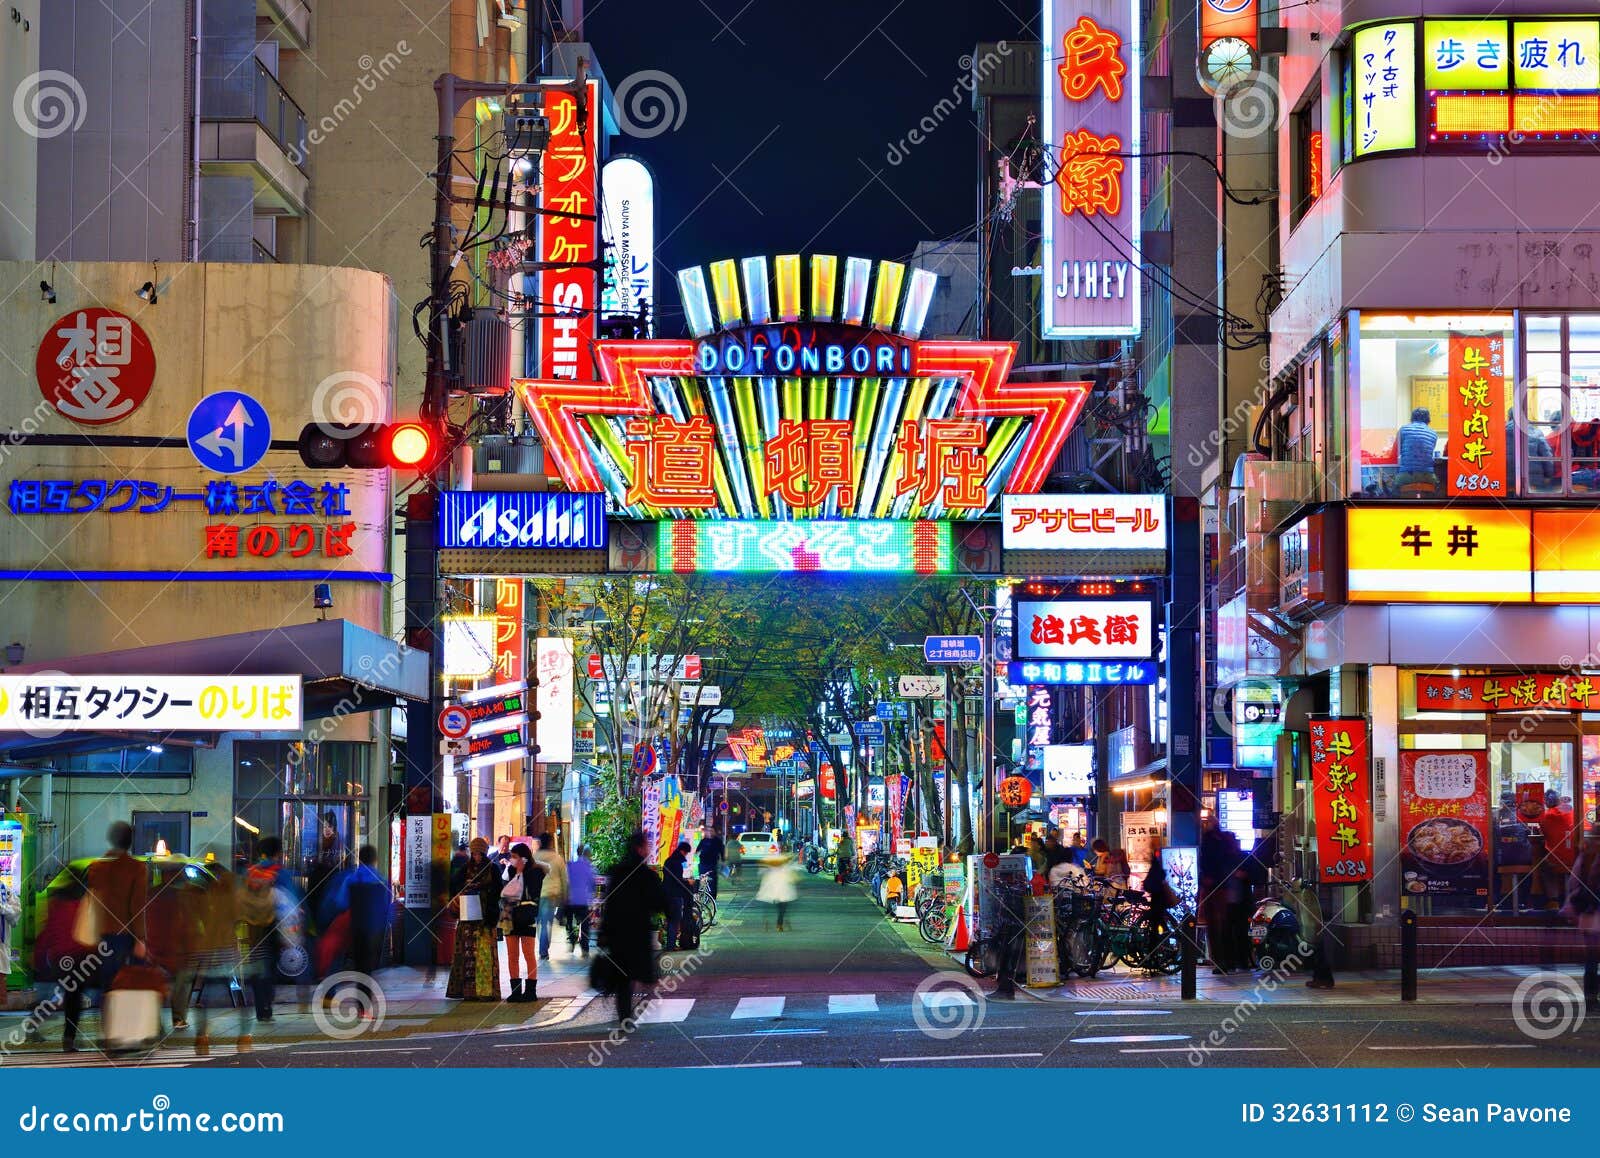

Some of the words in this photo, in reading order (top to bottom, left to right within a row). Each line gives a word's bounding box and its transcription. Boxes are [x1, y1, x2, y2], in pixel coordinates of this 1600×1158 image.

[1382, 29, 1399, 99] タイ古式
[1436, 37, 1586, 70] 歩き疲れ
[1362, 52, 1378, 150] マッサージ
[549, 98, 588, 273] カラオケ
[621, 199, 630, 230] SAUNA
[621, 232, 630, 240] &
[621, 240, 630, 283] MASSAGE
[1057, 260, 1130, 299] JIHEY
[701, 344, 911, 373] DOTONBORI
[1460, 346, 1492, 469] 牛焼肉丼
[626, 413, 989, 509] 道頓堀
[9, 479, 351, 516] 相互タクシー株式会社
[1455, 472, 1501, 491] 480円
[459, 496, 586, 544] Asahi
[205, 522, 358, 559] 南のりば
[1400, 525, 1479, 556] 牛丼
[1029, 614, 1139, 645] 治兵衛
[19, 684, 294, 720] 相互タクシーのりば
[1480, 676, 1600, 708] 牛焼肉丼
